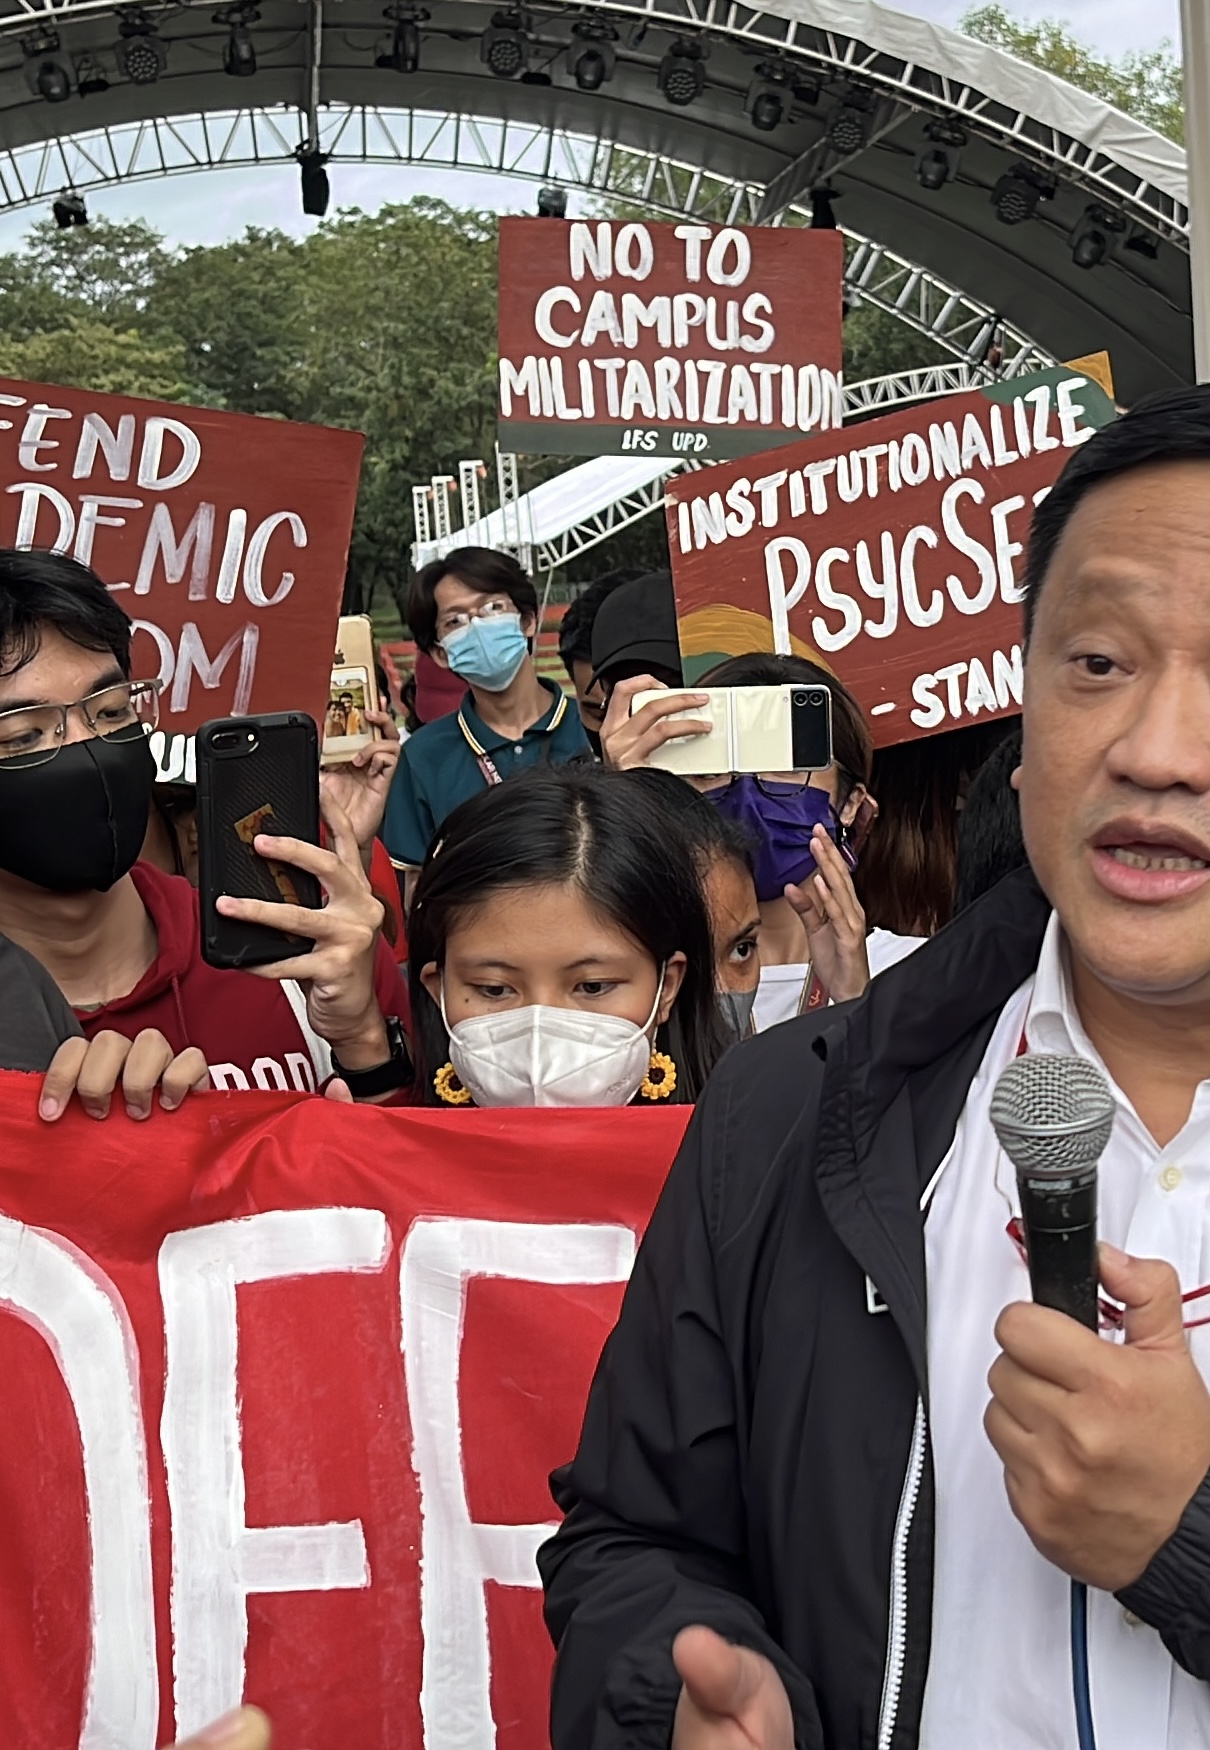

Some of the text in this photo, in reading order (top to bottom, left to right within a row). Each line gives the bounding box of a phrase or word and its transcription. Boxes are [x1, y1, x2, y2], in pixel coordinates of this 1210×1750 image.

[569, 222, 751, 287] NO TO
[534, 286, 775, 354] CAMPUS
[498, 356, 844, 432] MILITARIZATION
[622, 429, 659, 451] LFS
[678, 376, 1097, 554] INSTITUTIONALIZE
